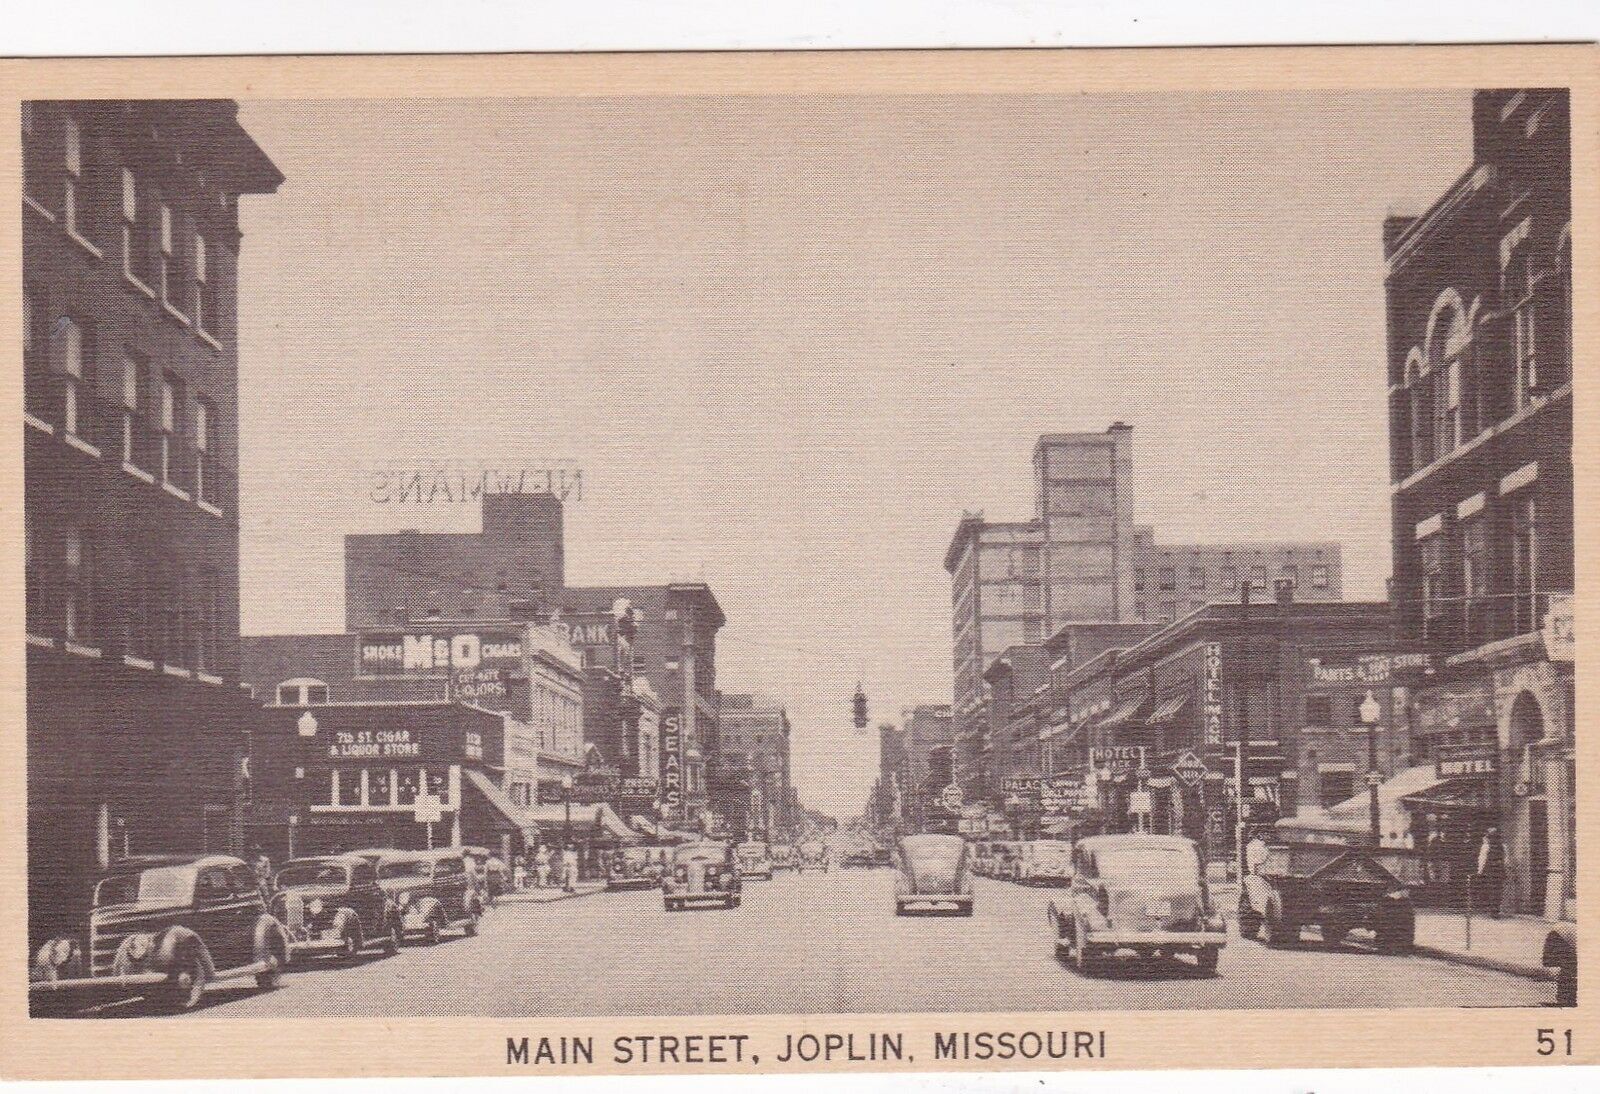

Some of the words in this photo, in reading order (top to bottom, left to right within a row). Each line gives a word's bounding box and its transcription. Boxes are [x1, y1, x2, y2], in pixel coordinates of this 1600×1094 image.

[1205, 642, 1223, 703] HOTEL
[376, 730, 410, 743] CIGAR
[342, 743, 380, 758] LIQUOR
[384, 742, 419, 756] STORE
[1095, 747, 1138, 760] HOTEL
[664, 717, 681, 807] SEARS
[1441, 760, 1495, 775] HOTEL
